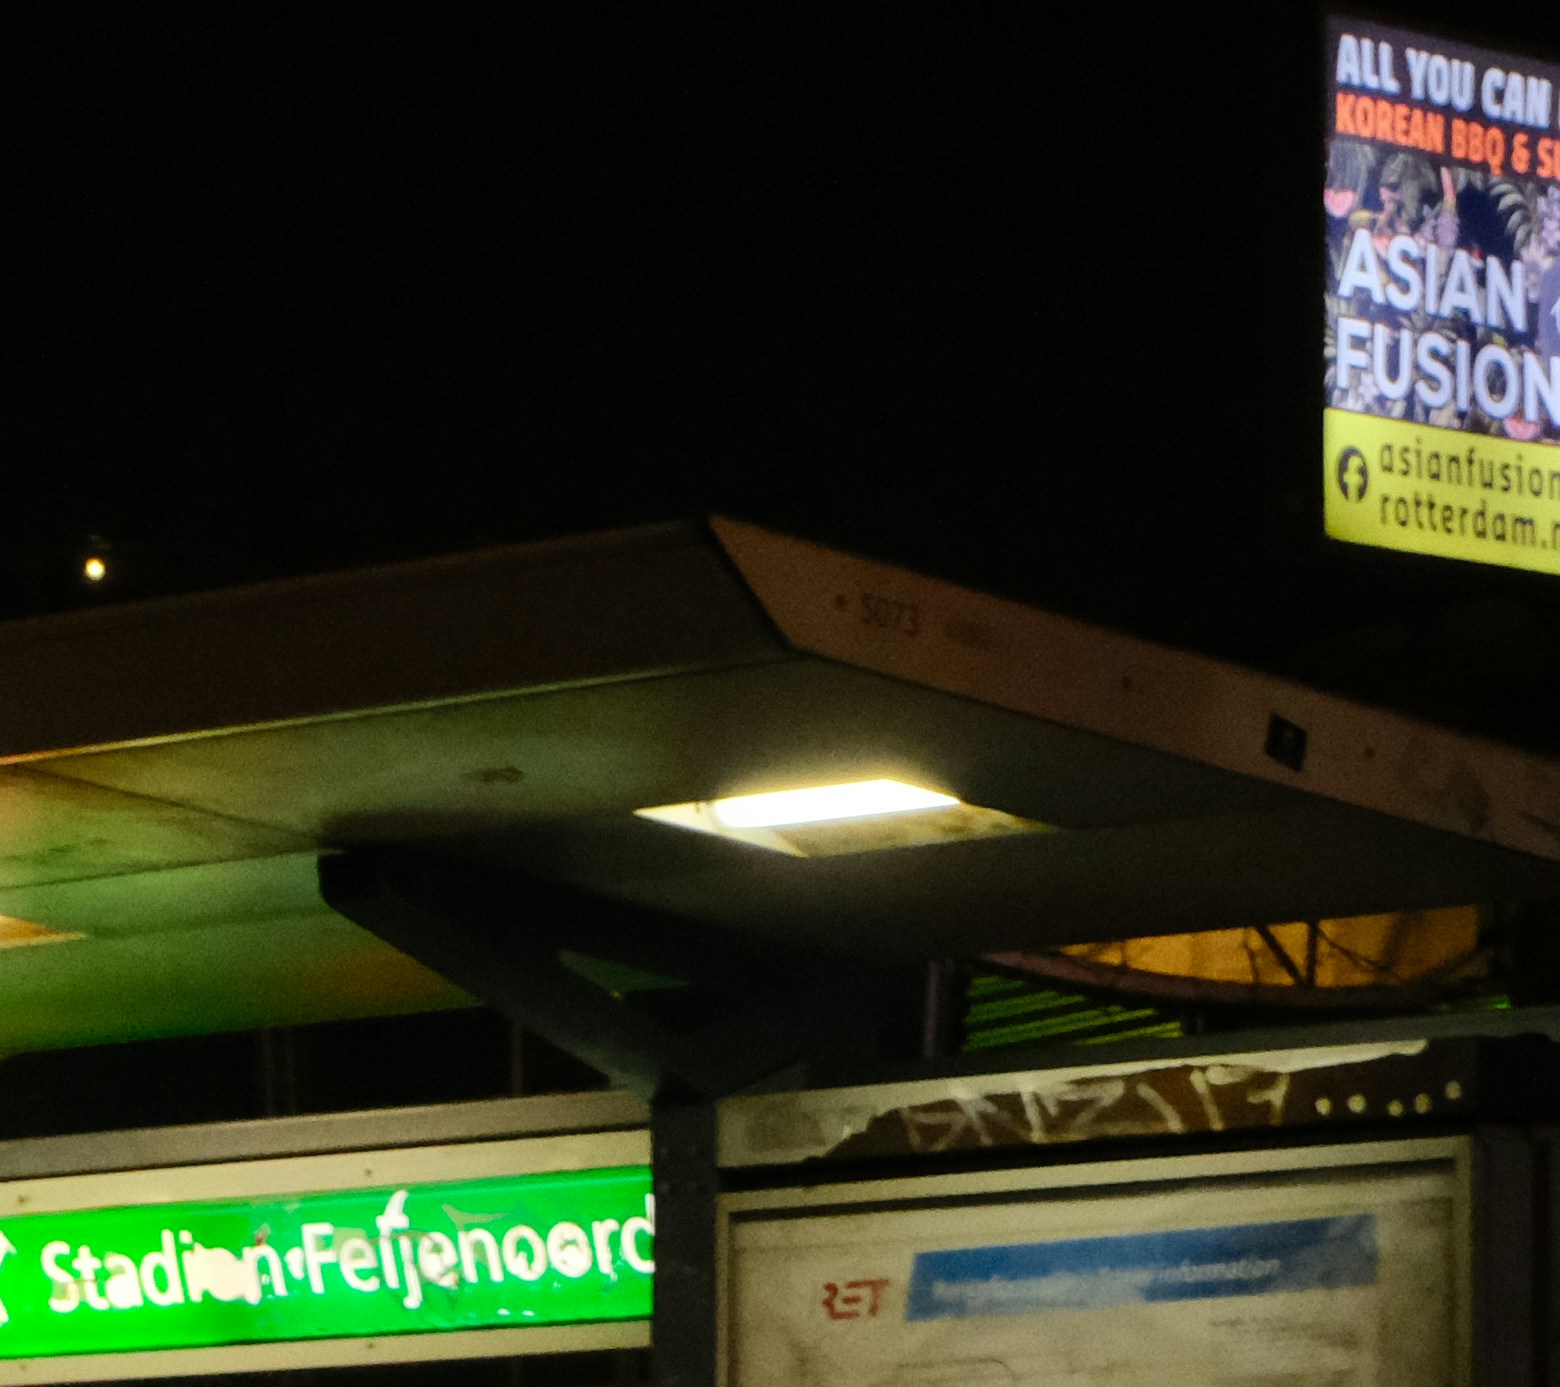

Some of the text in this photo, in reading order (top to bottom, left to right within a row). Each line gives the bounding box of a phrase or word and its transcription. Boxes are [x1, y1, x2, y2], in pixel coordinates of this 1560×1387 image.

[1336, 33, 1400, 94] ALL
[1406, 48, 1476, 111] YOU
[1482, 67, 1551, 130] CAN
[1335, 91, 1445, 155] KOREAN
[1451, 118, 1505, 176] BBQ
[1512, 134, 1530, 174] &
[1337, 228, 1527, 333] ASIAN
